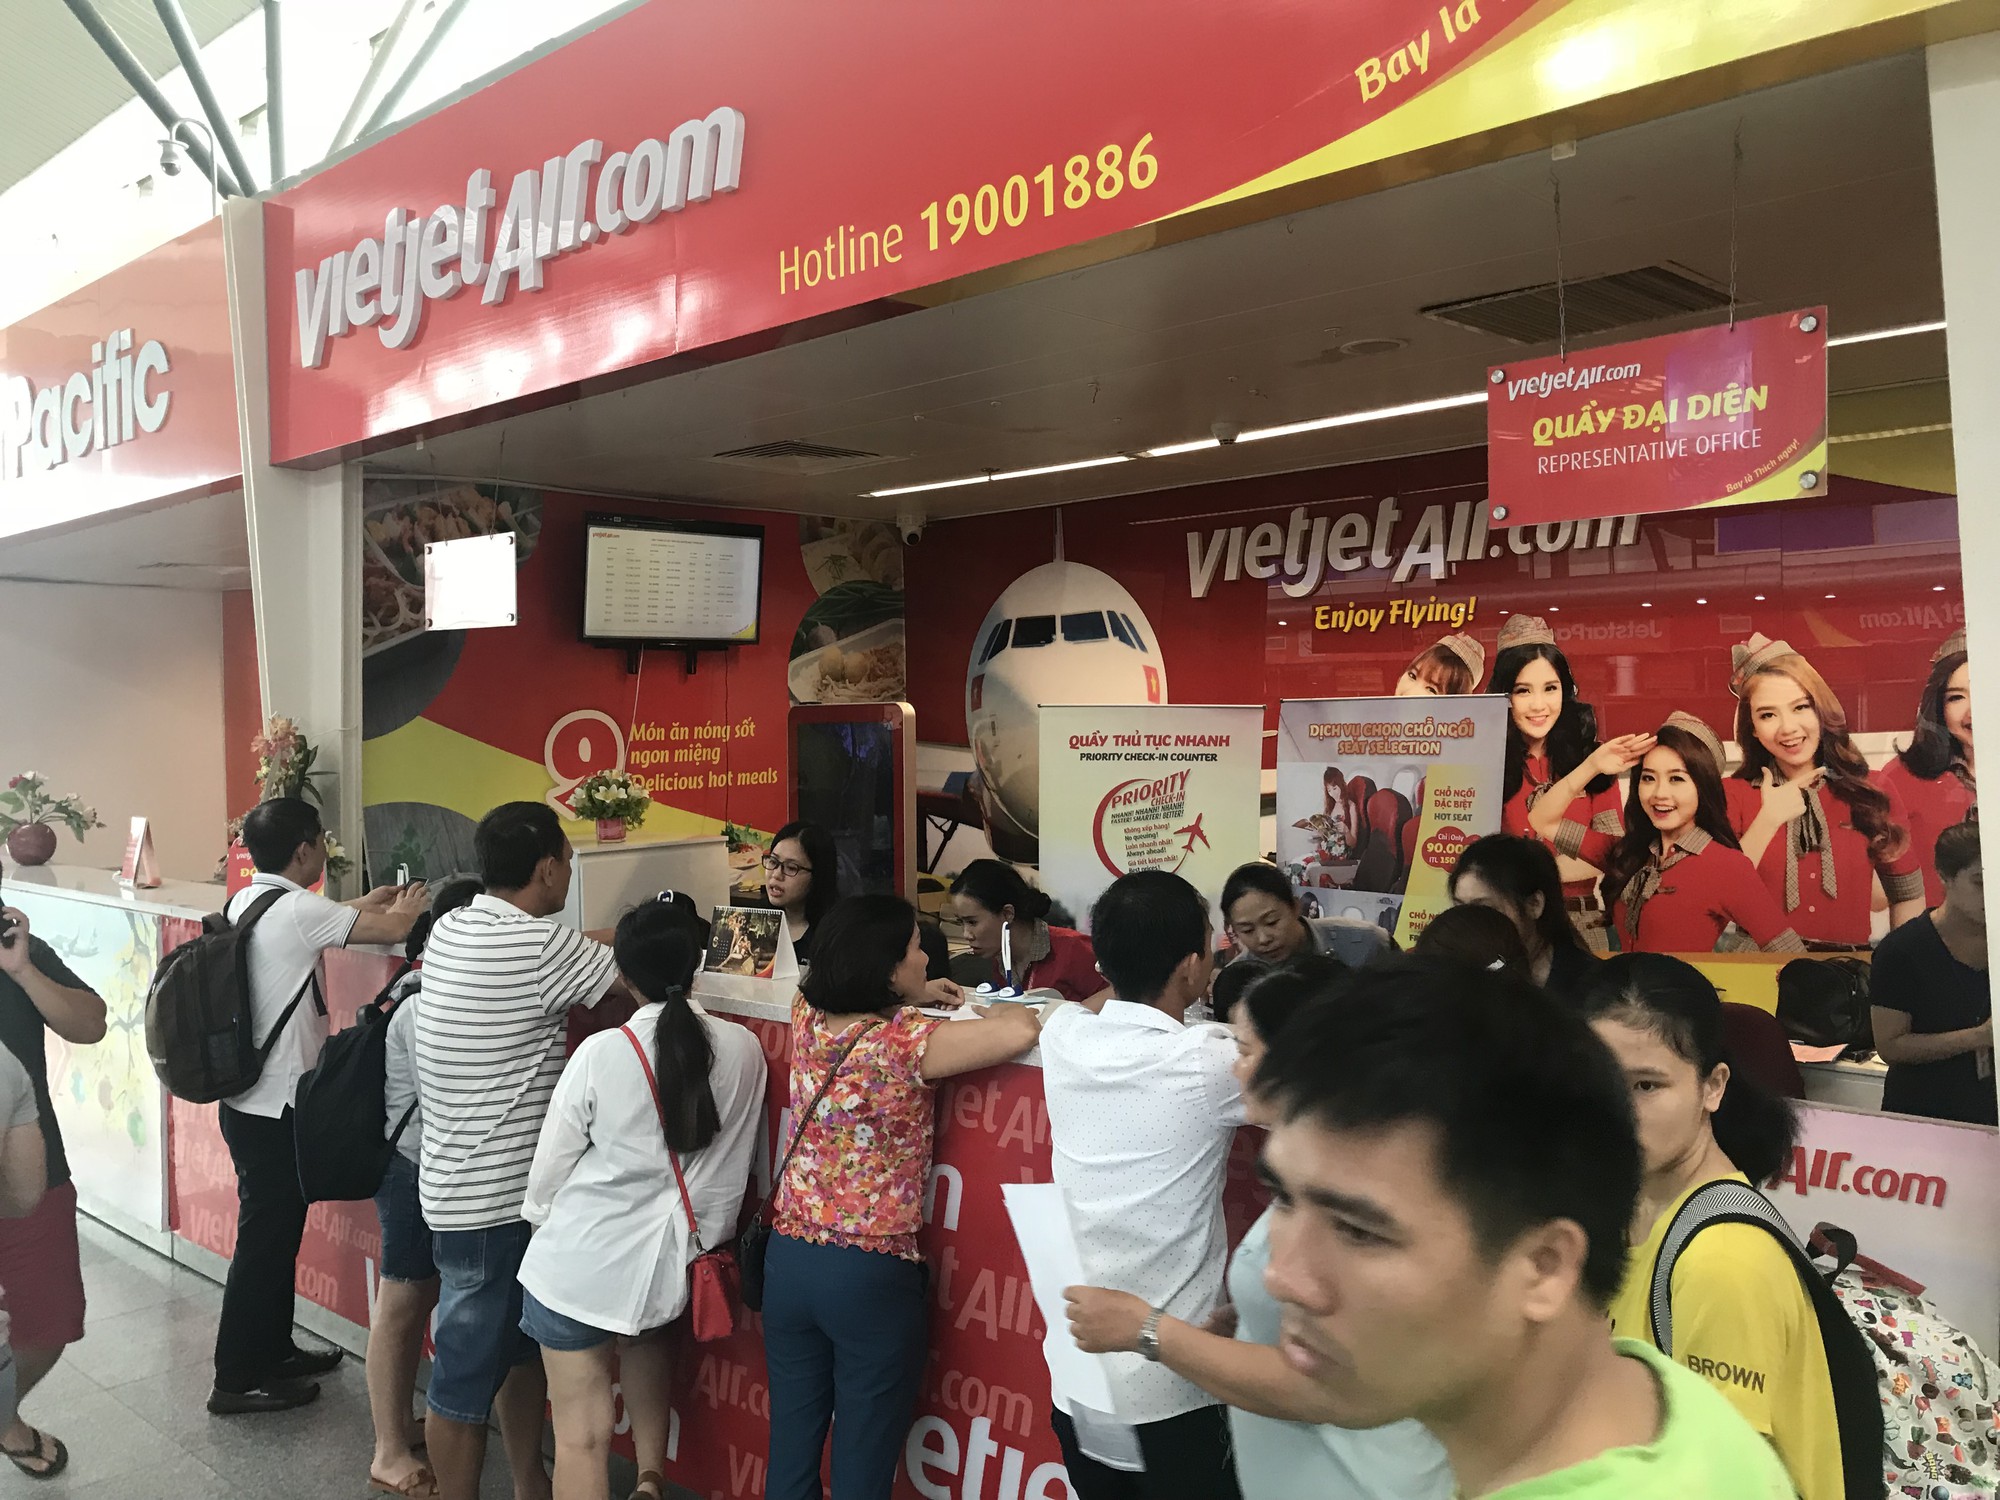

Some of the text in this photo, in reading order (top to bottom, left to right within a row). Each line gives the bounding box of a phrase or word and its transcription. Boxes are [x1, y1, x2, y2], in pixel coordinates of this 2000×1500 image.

[1354, 30, 1430, 104] Bay
[779, 132, 1159, 295] Hotline 19001886
[2, 327, 171, 478] Pacific
[1532, 382, 1769, 447] QUẦY ĐẠI DIỆN
[1537, 428, 1762, 475] REPRESENTATIVE OFFICE
[1725, 480, 1744, 493] Bay
[1314, 595, 1478, 633] Enjoy Flying!
[630, 717, 756, 742] Món ăn nóng sốt
[1068, 729, 1231, 751] QUẦY THỦ TỤC NHANH
[1309, 723, 1342, 741] DỊCH
[1342, 723, 1361, 741] VỤ
[1362, 723, 1401, 741] CHỌN
[1403, 716, 1435, 738] CHỖ
[630, 743, 721, 768] ngon miệng
[1079, 752, 1218, 761] PRIORITY CHECK-IN COUNTER
[1337, 740, 1441, 756] SEAT SELECTION
[631, 767, 778, 792] Delicious hot meals
[1111, 768, 1191, 809] PRIORITY
[1150, 790, 1186, 807] CHECK-IN
[1434, 813, 1472, 822] HOT SEAT
[1450, 834, 1464, 842] Only
[1686, 1353, 1766, 1394] BROWN
